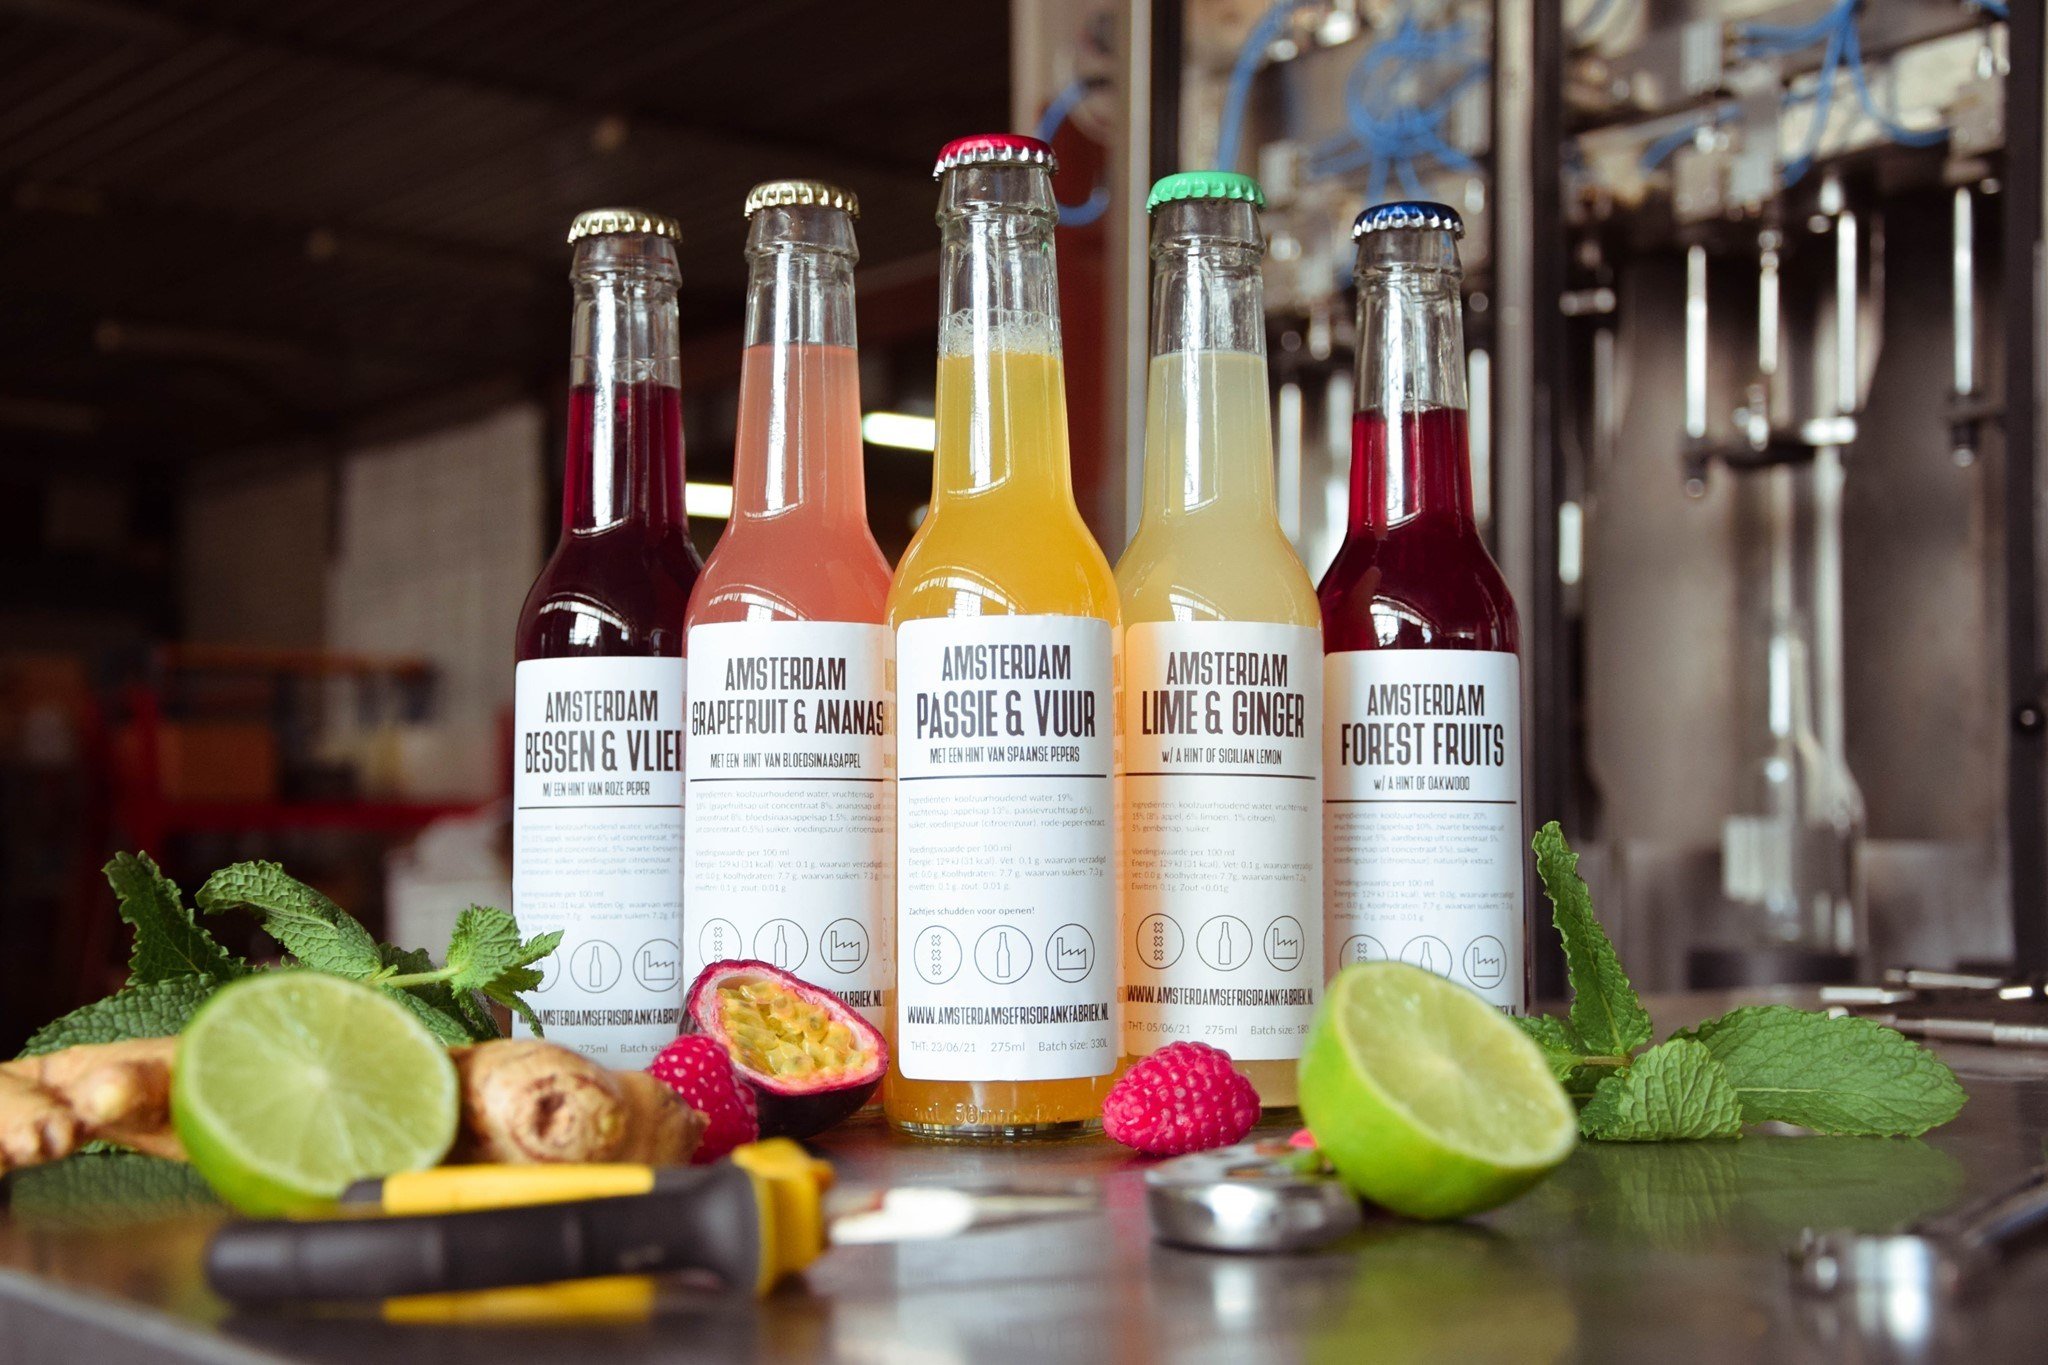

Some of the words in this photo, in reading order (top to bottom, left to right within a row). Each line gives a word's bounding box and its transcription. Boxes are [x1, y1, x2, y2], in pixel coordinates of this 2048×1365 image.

[725, 657, 846, 690] AMSTERDAM
[942, 645, 1071, 681] AMSTERDAM
[1167, 651, 1287, 687] AMSTERDAM
[546, 690, 658, 723] AMSTERDAM
[1367, 684, 1484, 716] AMSTERDAM
[692, 699, 788, 736] GRAPEFRUIT
[794, 699, 807, 733] &
[815, 699, 884, 736] ANANAS
[917, 690, 998, 739] PASSIE
[1006, 690, 1024, 736] &
[1034, 690, 1095, 737] VUUR
[1142, 690, 1197, 735] LIME
[1205, 691, 1223, 734] &
[1233, 690, 1304, 738] GINGER
[526, 730, 594, 773] BESSEN
[602, 730, 618, 771] &
[930, 748, 946, 763] MET
[949, 747, 963, 763] EEN
[965, 747, 984, 762] HINT
[987, 747, 1004, 762] VAN
[1007, 746, 1048, 762] SPAANSE
[1051, 746, 1079, 762] PEPERS
[1162, 747, 1173, 763] w/
[1176, 748, 1181, 762] A
[1184, 748, 1203, 762] HINT
[1206, 748, 1216, 763] OF
[1219, 748, 1254, 763] SICILIAN
[1257, 749, 1281, 764] LEMON
[1342, 723, 1425, 766] FOREST
[1434, 723, 1504, 767] FRUITS
[711, 754, 724, 768] MET
[727, 753, 739, 768] EEN
[744, 753, 761, 767] HINT
[765, 753, 780, 767] VAN
[783, 753, 861, 768] BLOEDSINAASAPPEL
[554, 783, 566, 796] EEN
[568, 782, 584, 796] HINT
[588, 782, 602, 795] VAN
[605, 781, 624, 796] ROZE
[626, 781, 650, 795] PEPER
[1374, 776, 1385, 791] w/
[1388, 776, 1393, 790] A
[1396, 776, 1414, 790] HINT
[1416, 776, 1425, 790] OF
[1428, 776, 1470, 790] OAKWOOD
[909, 907, 935, 918] Zachtjes
[937, 907, 975, 915] schudden
[998, 906, 1035, 917] openen!
[1126, 985, 1313, 1006] WWW.AMSTERDAMSEFRISDRANKFABRIEK.NL
[908, 1003, 1109, 1025] WWW.AMSTERDAMSEFRISDRANKFABRIEK.NL
[1146, 1020, 1190, 1036] 05/06/21
[1205, 1024, 1237, 1035] 275ml
[1251, 1025, 1276, 1037] Batch
[1278, 1024, 1296, 1037] size:
[620, 1043, 648, 1053] Batch
[991, 1042, 1025, 1052] 275ml
[1039, 1041, 1067, 1052] Batch
[1069, 1040, 1088, 1051] size:
